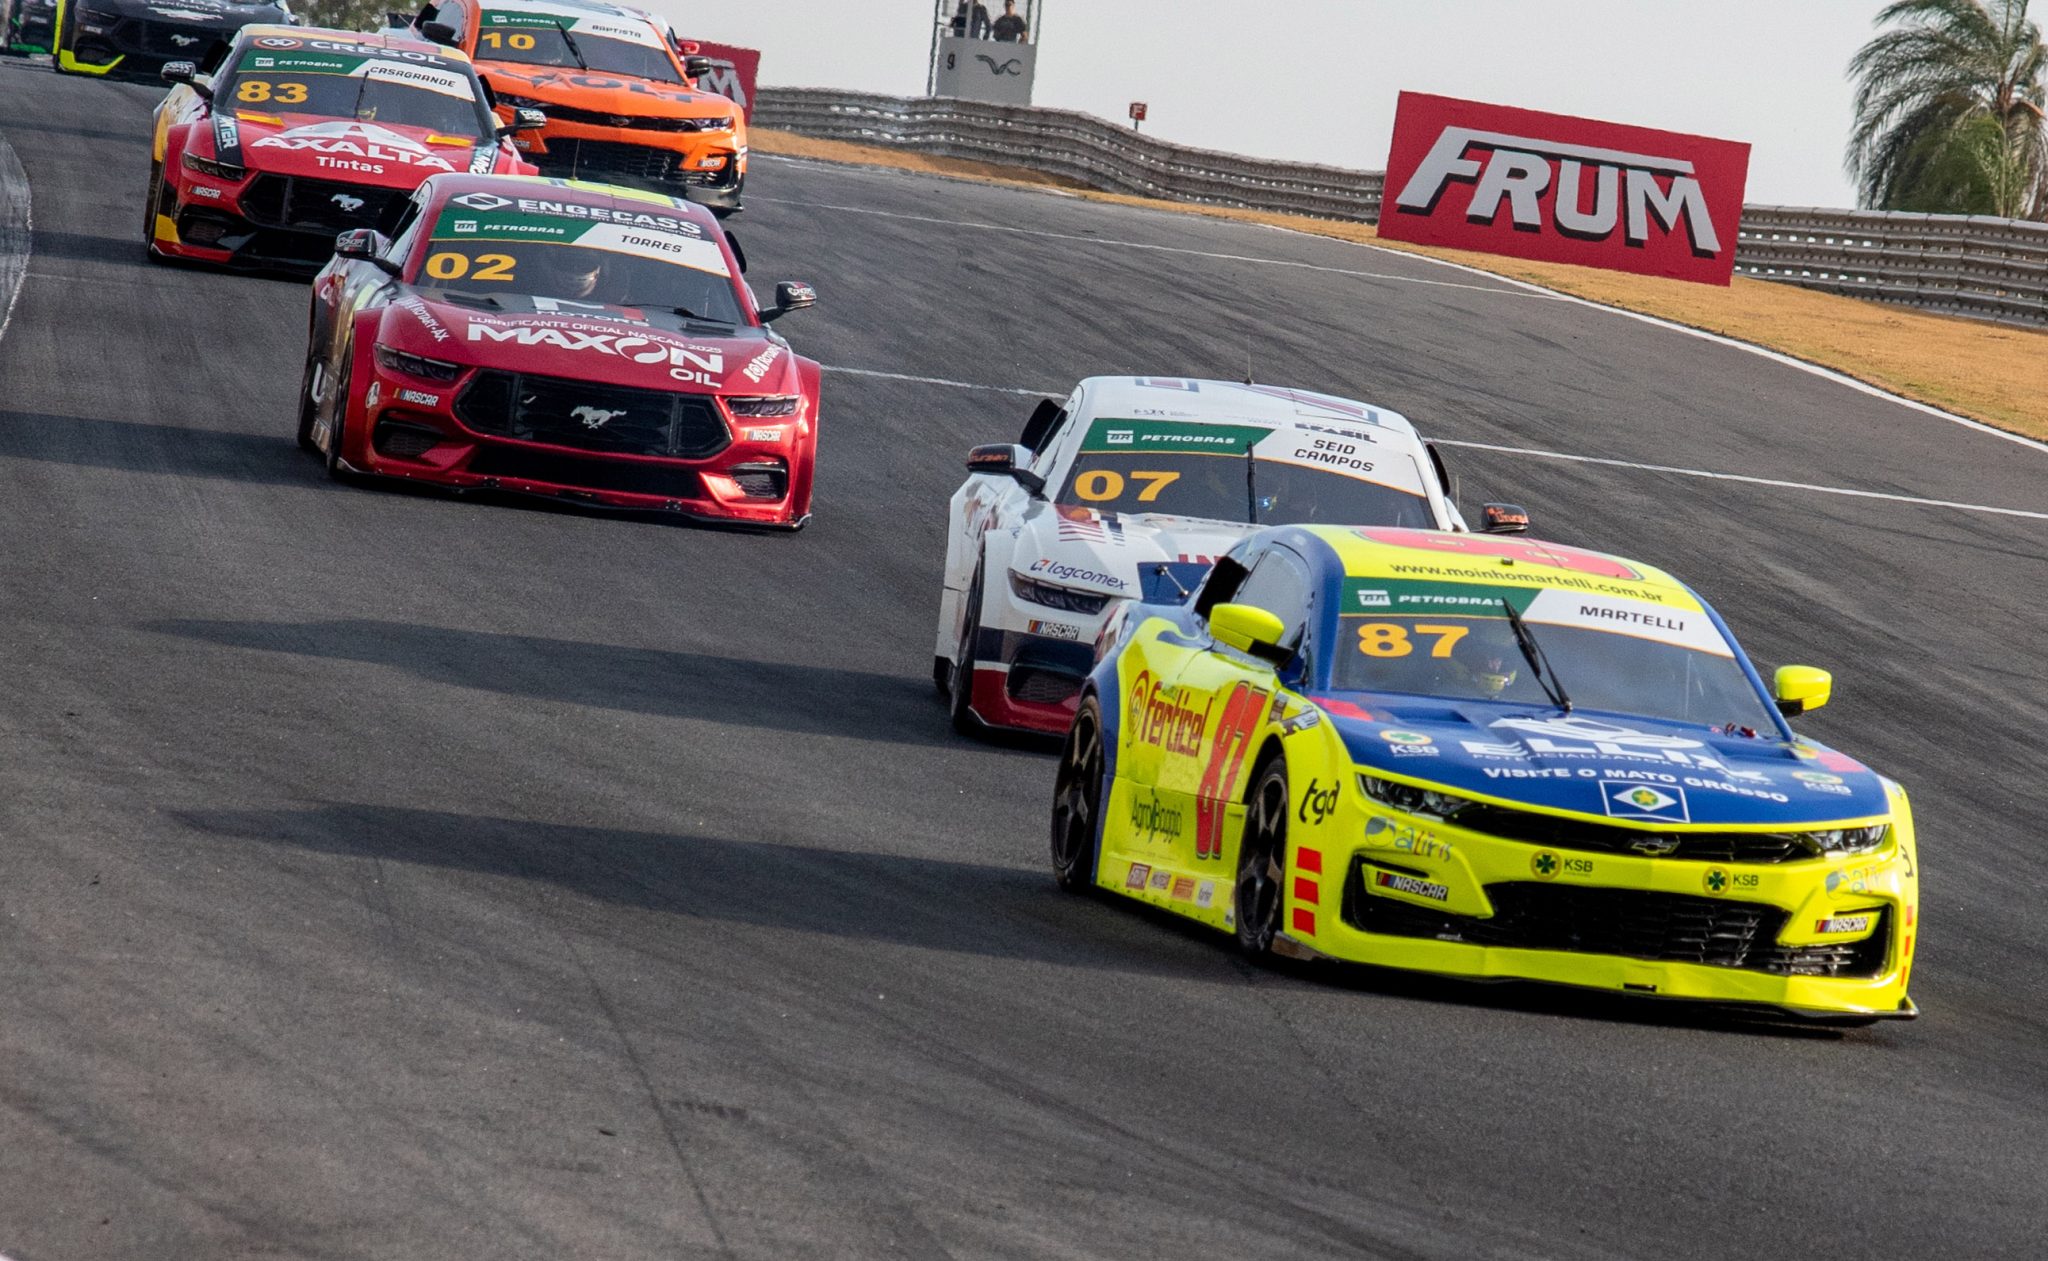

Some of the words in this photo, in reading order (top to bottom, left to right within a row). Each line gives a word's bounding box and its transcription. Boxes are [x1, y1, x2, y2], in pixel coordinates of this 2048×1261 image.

[481, 32, 536, 50] 10
[591, 24, 642, 39] BAPTISTA
[278, 59, 344, 69] PETROBRAS
[310, 41, 448, 66] CRESOL
[369, 65, 457, 89] CASAGRANDE
[236, 80, 309, 105] 83
[250, 136, 456, 173] AXALTA
[315, 155, 385, 175] Tintas
[1394, 124, 1722, 253] FRUM
[518, 198, 702, 236] ENGECASS
[483, 224, 565, 234] PETROBRAS
[621, 234, 683, 254] TORRES
[425, 252, 517, 281] 02
[536, 310, 650, 327] MOTORS
[467, 315, 572, 332] LUBRIFICANTE
[573, 322, 623, 336] OFICIAL
[627, 329, 688, 348] NASCAR
[687, 343, 723, 355] 2025
[467, 324, 724, 375] MAXON
[669, 367, 722, 389] OIL
[404, 389, 439, 407] NASCAR
[1140, 434, 1236, 445] PETROBRAS
[1312, 439, 1357, 455] SEID
[1294, 448, 1375, 472] CAMPOS
[1074, 469, 1182, 502] 07
[1047, 561, 1129, 590] logcomex
[1389, 561, 1665, 603] www.moinhomartelli.com.br
[1399, 594, 1506, 606] PETROBRAS
[1580, 605, 1685, 632] MARTELLI
[1040, 622, 1080, 640] NASCAR
[1357, 622, 1470, 659] 87
[1389, 744, 1440, 754] KSB
[1483, 767, 1571, 778] VISITE
[1577, 768, 1598, 777] O
[1603, 769, 1677, 783] MATO
[1683, 776, 1790, 803] GROSSO
[1564, 858, 1594, 873] KSB
[1393, 876, 1448, 900] NASCAR
[1732, 874, 1760, 887] KSB
[1828, 917, 1868, 932] NASCAR
